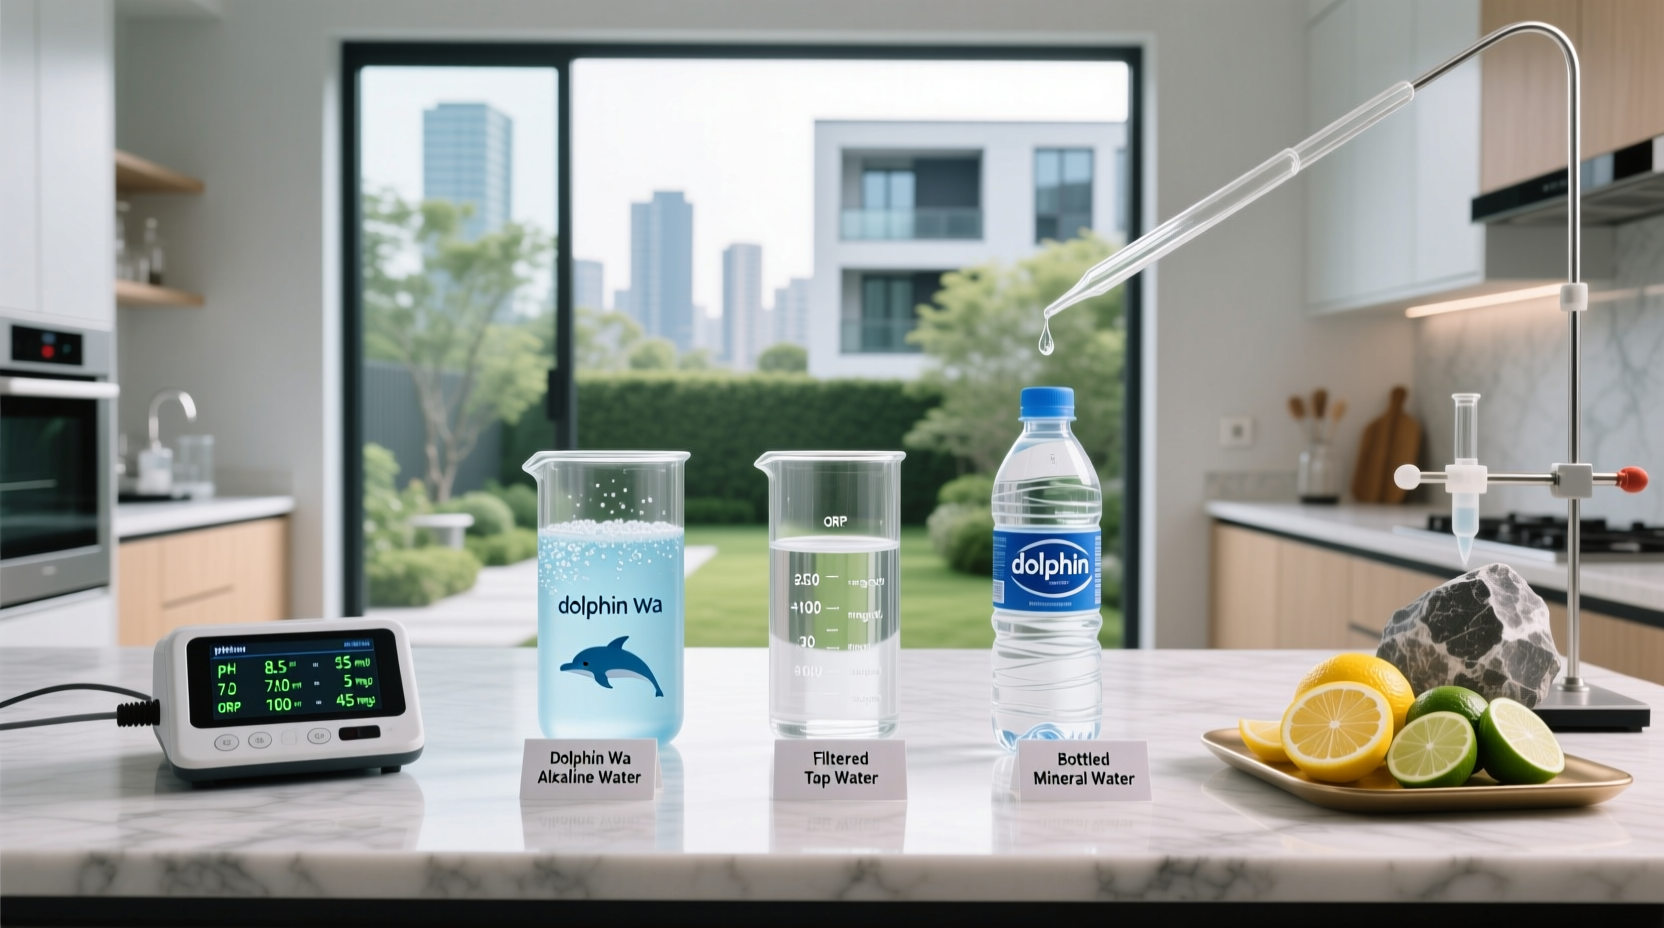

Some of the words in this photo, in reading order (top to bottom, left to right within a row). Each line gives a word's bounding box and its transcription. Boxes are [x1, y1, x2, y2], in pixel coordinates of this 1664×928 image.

[824, 516, 848, 527] ORP
[1012, 551, 1089, 580] dolphin
[558, 595, 628, 620] dolphin
[633, 597, 662, 613] Wa
[218, 662, 237, 679] pH
[264, 660, 288, 675] 8.5
[344, 674, 353, 688] 5
[217, 701, 242, 714] ORP
[266, 697, 292, 711] 100
[336, 693, 355, 707] 45
[550, 750, 604, 769] Dolphin
[608, 751, 631, 765] Wa
[813, 751, 869, 766] Filtered
[1058, 751, 1110, 766] Bottled
[537, 768, 595, 784] Alkaline
[598, 769, 642, 784] Water
[834, 770, 879, 785] Water
[1033, 770, 1088, 786] Mineral
[1091, 770, 1136, 786] Water
